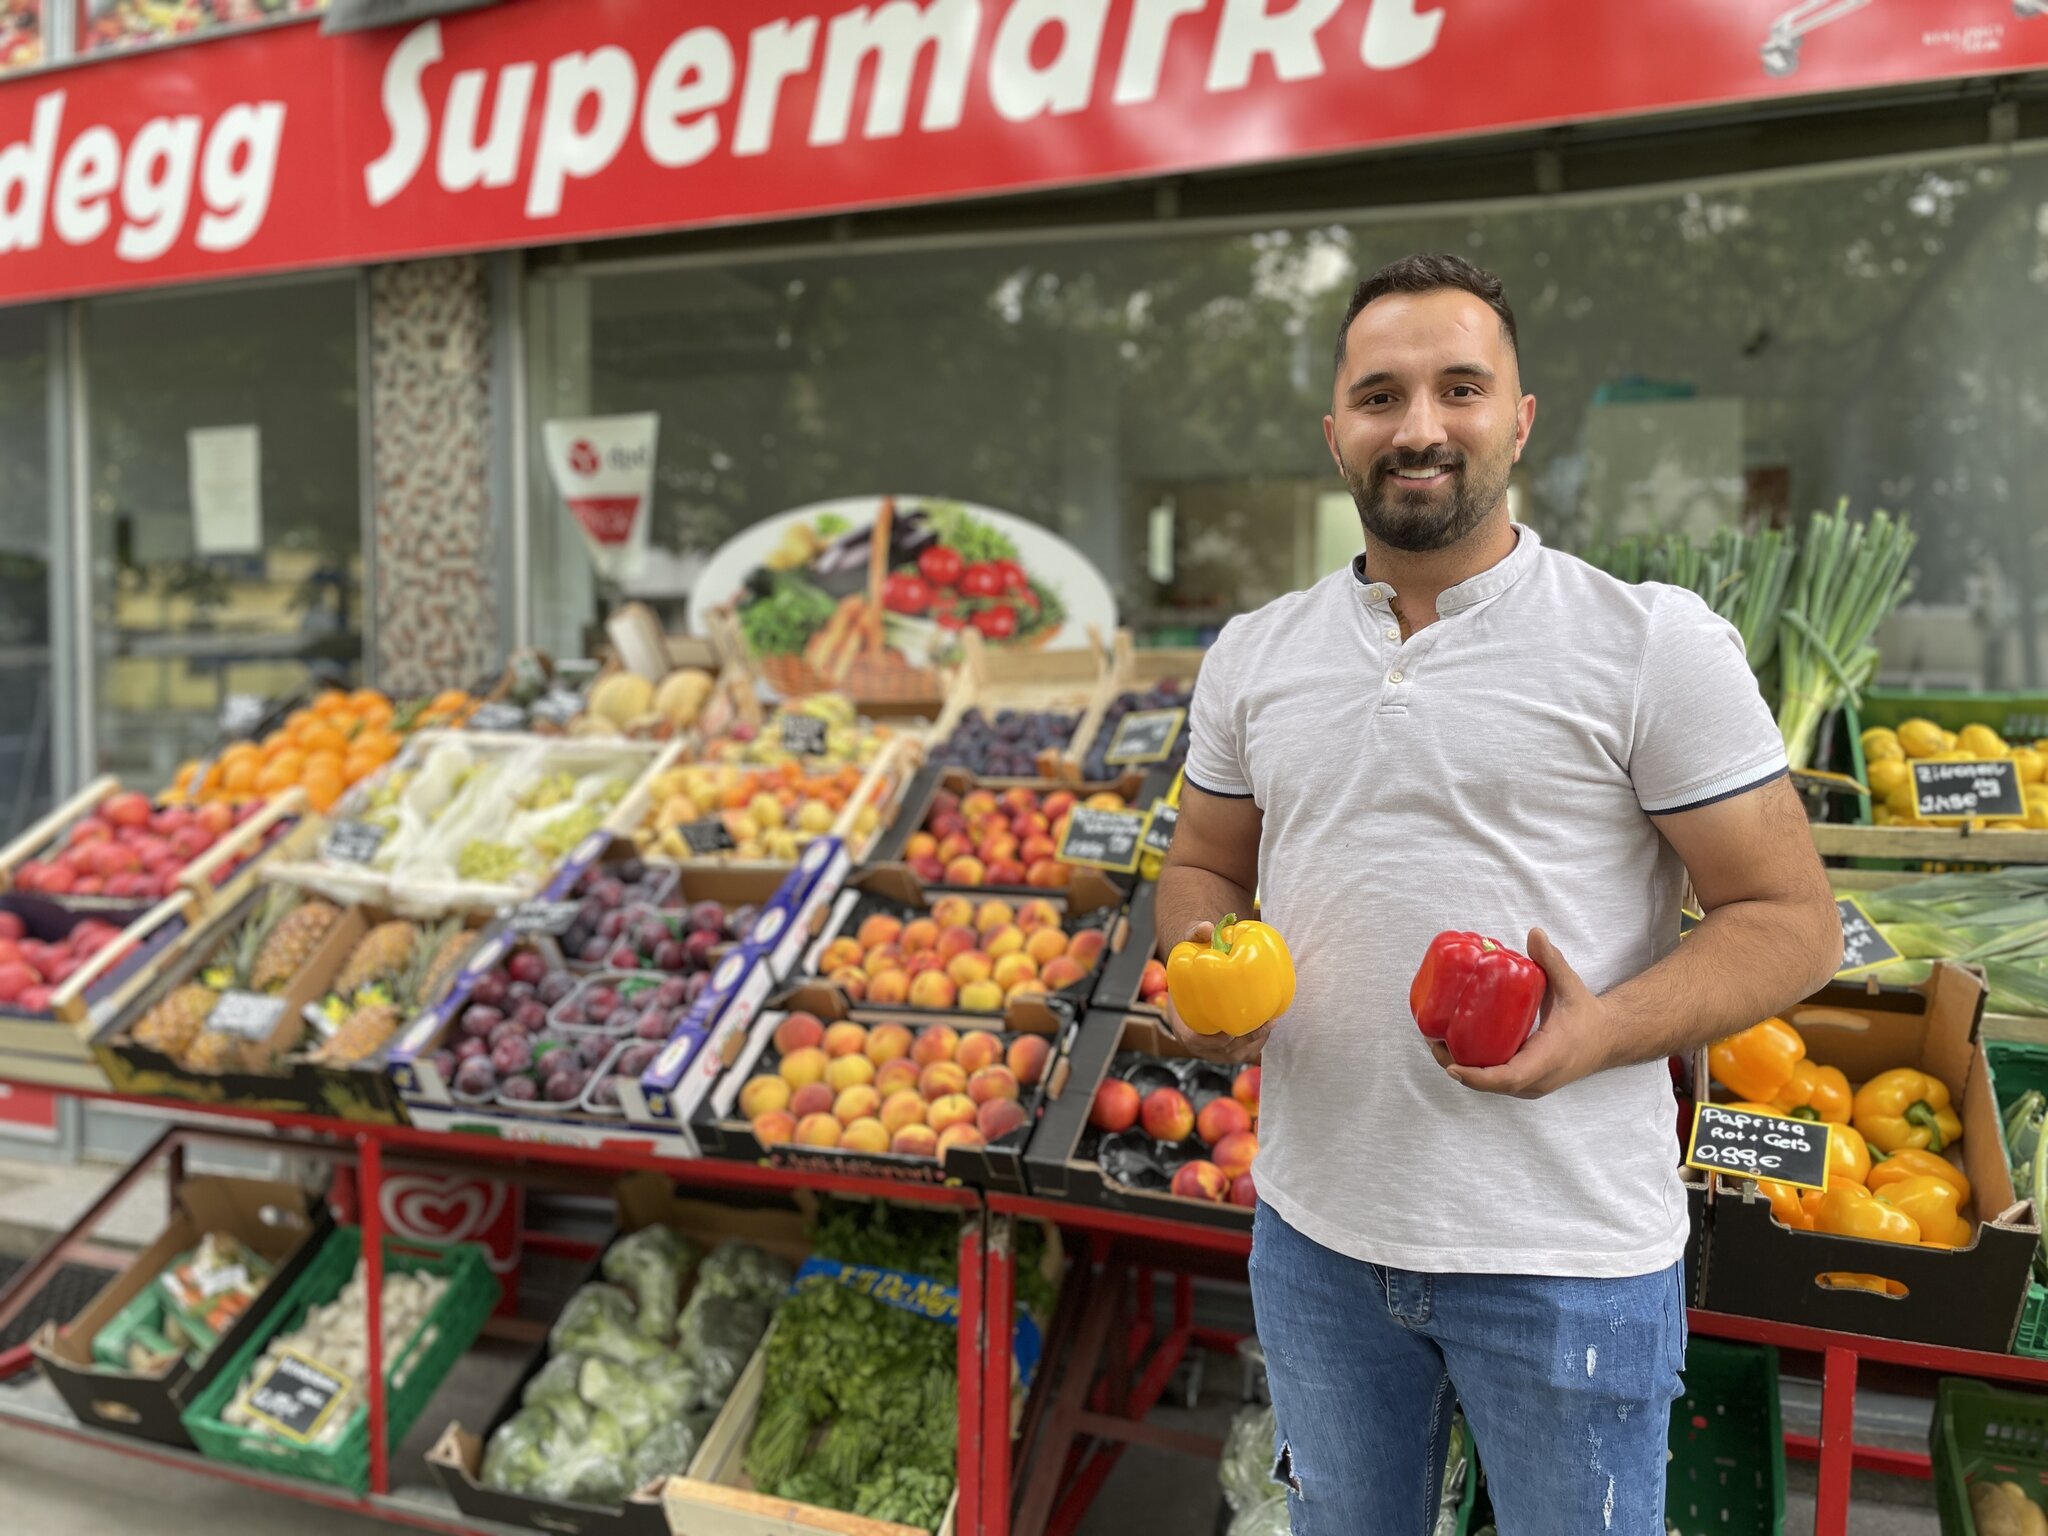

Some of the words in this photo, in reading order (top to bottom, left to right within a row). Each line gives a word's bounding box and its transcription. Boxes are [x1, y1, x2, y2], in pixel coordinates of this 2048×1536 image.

[1702, 1108, 1806, 1137] Paprika
[1710, 1127, 1745, 1141] Rot
[1749, 1132, 1759, 1142] +
[1695, 1144, 1783, 1169] 0,99€
